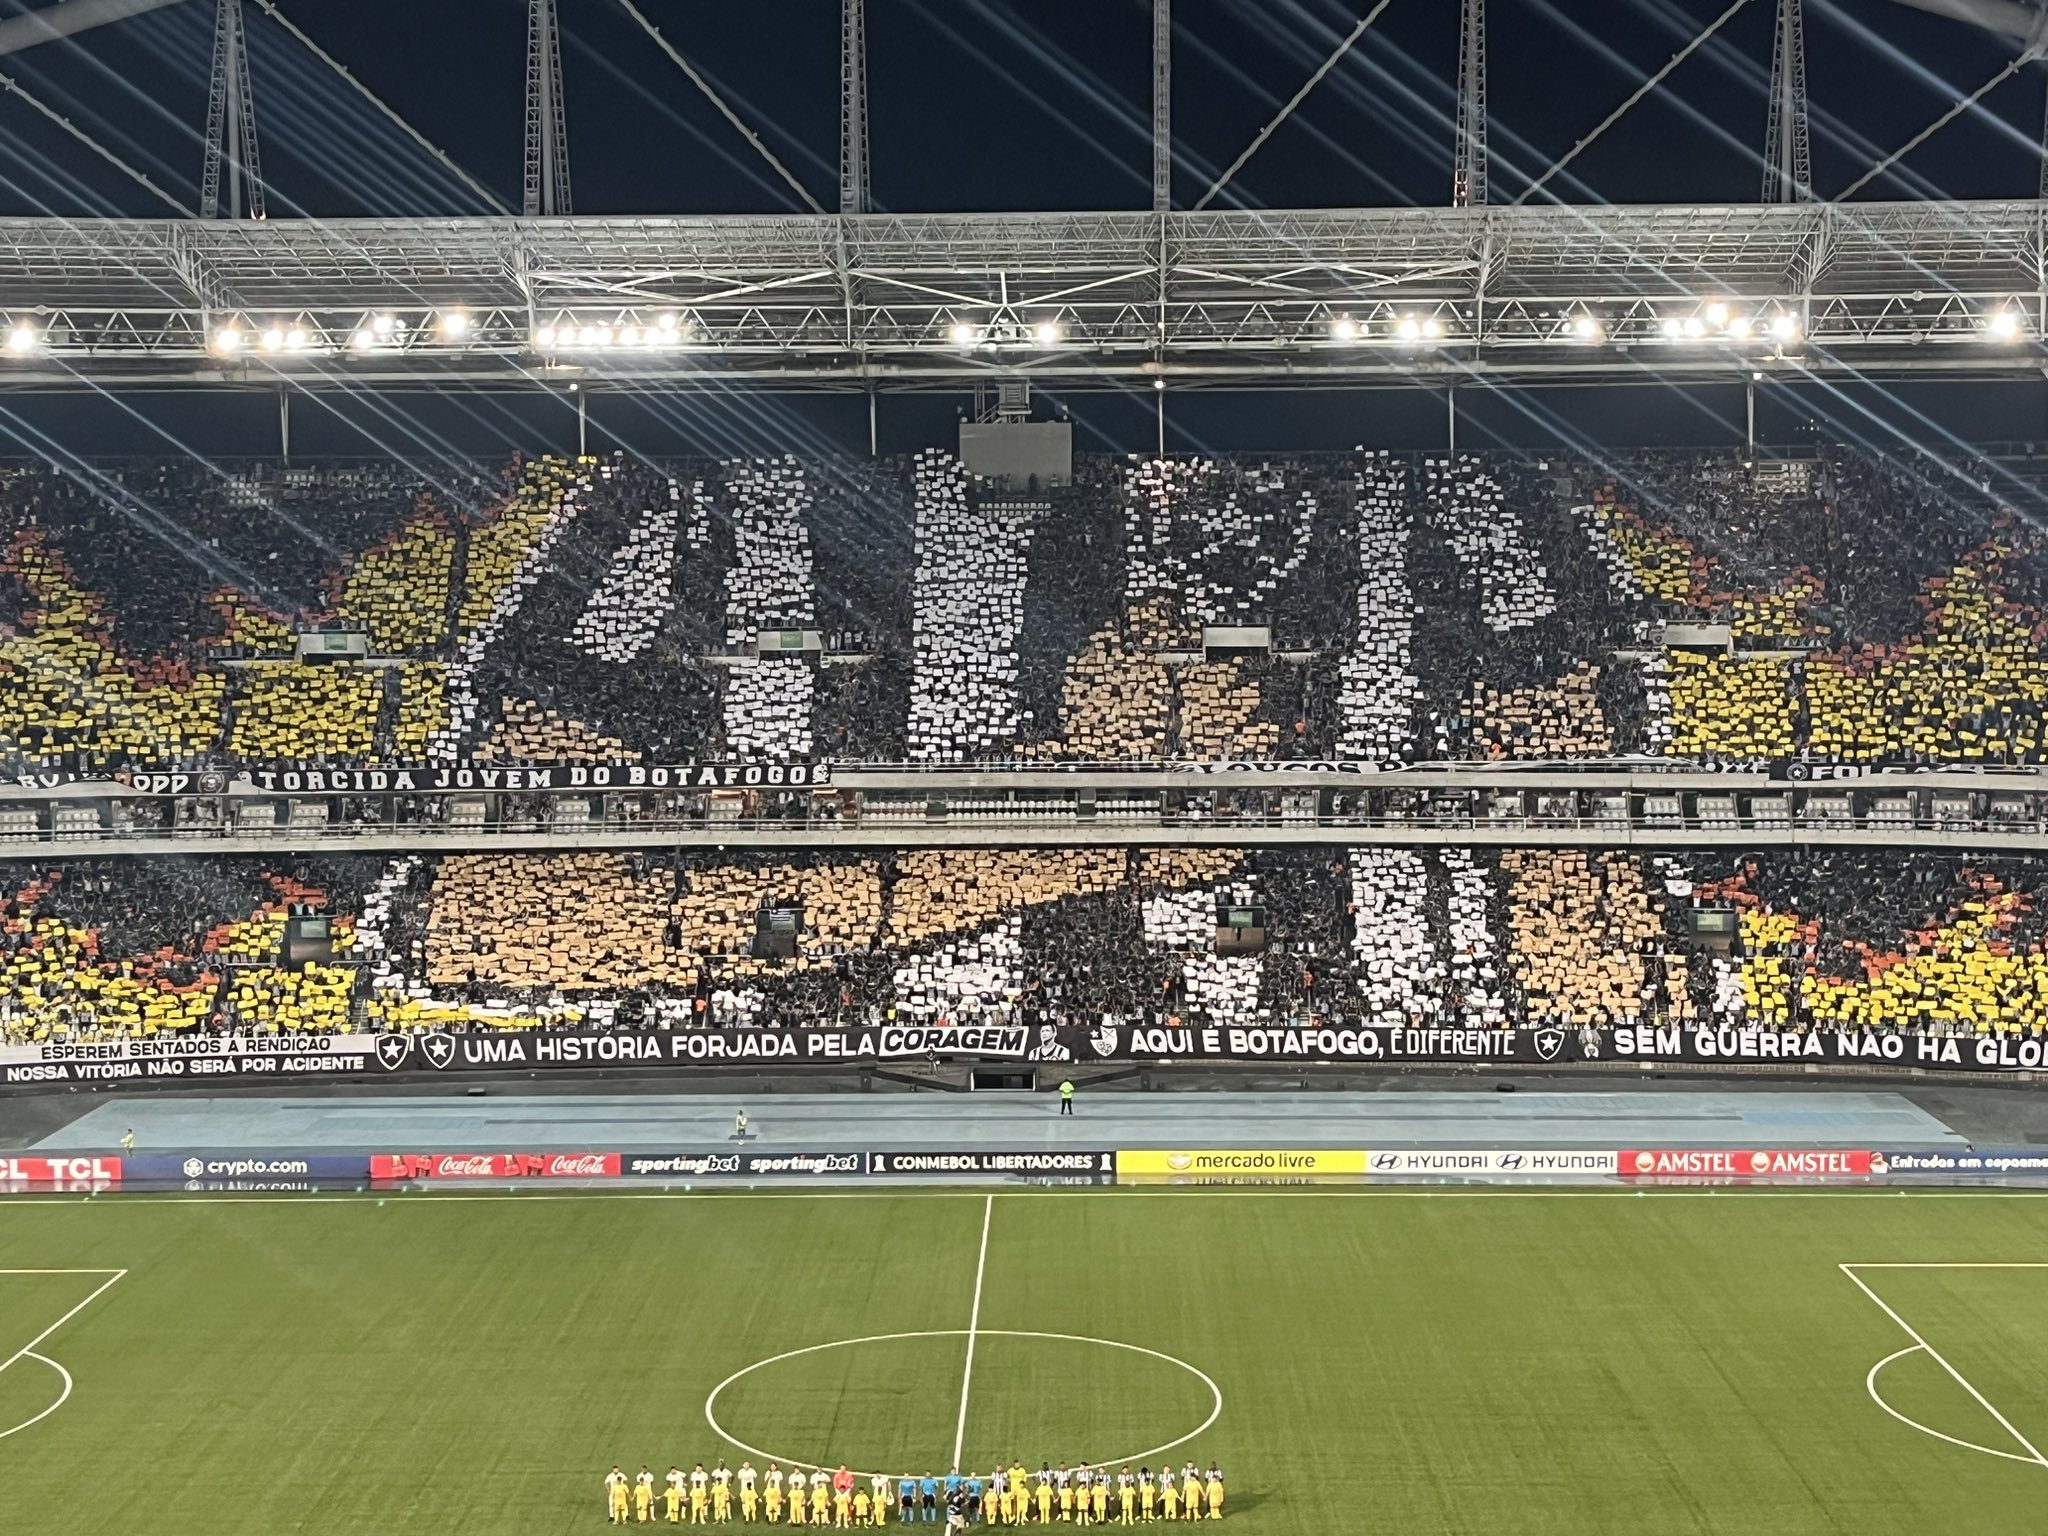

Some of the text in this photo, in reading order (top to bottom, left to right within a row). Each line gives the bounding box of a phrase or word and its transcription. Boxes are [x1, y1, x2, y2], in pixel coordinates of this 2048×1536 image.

[258, 766, 806, 790] TORCIDA JOVEM DO BOTAFOGO
[41, 1045, 122, 1060] ESPEREM
[130, 1040, 220, 1056] SENTADOS
[464, 1029, 1024, 1062] UMA HISTÓRIA FORJADA PELA CORAGEM
[1130, 1029, 1194, 1053] AQUI
[1229, 1029, 1384, 1058] BOTAFOGO,
[1406, 1029, 1515, 1055] DIFERENTE
[1614, 1028, 1681, 1054] SEM
[1695, 1030, 1824, 1057] GUERRA
[7, 1056, 364, 1081] NOSSA VITÓRIA NÃO SERÁ POR ACIDENTE
[47, 1158, 111, 1179] TCL
[207, 1159, 307, 1175] crypto.com
[632, 1155, 740, 1174] sportingbet
[750, 1154, 858, 1173] sportingbet
[893, 1154, 1093, 1170] CONMEBOL LIBERTADORES
[1196, 1153, 1315, 1168] mercado livre
[1408, 1156, 1488, 1168] HYUNDAI
[1533, 1156, 1613, 1168] HYUNDAI
[1657, 1153, 1735, 1172] AMSTEL
[1772, 1153, 1851, 1172] AMSTEL
[1891, 1154, 1955, 1168] Entradas
[1958, 1158, 1981, 1168] em
